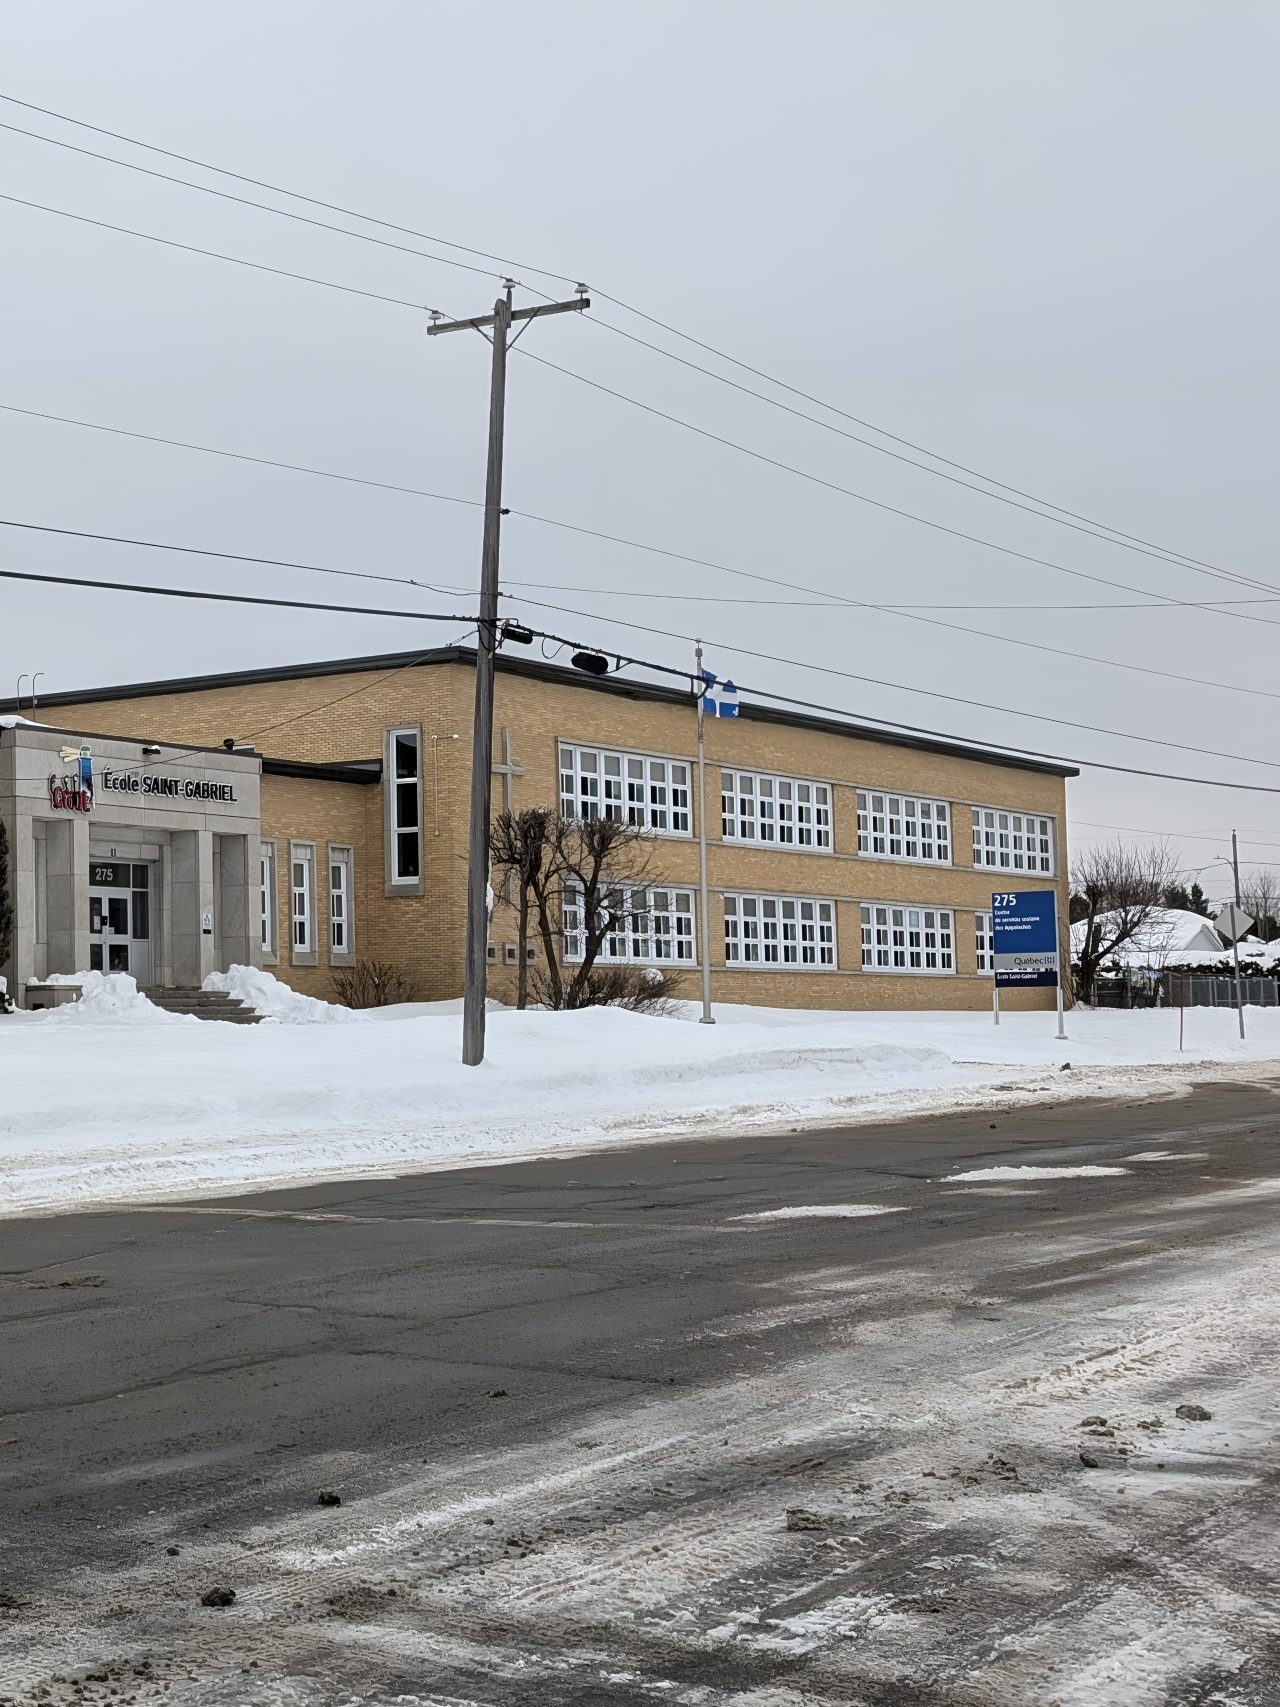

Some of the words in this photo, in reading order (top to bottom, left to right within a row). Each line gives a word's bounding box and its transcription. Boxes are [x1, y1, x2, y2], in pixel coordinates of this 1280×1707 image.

[103, 766, 139, 792] École
[142, 775, 238, 803] SAINT-GABRIEL
[95, 868, 113, 881] 275
[994, 894, 1016, 907] 275
[1014, 957, 1043, 966] Québec
